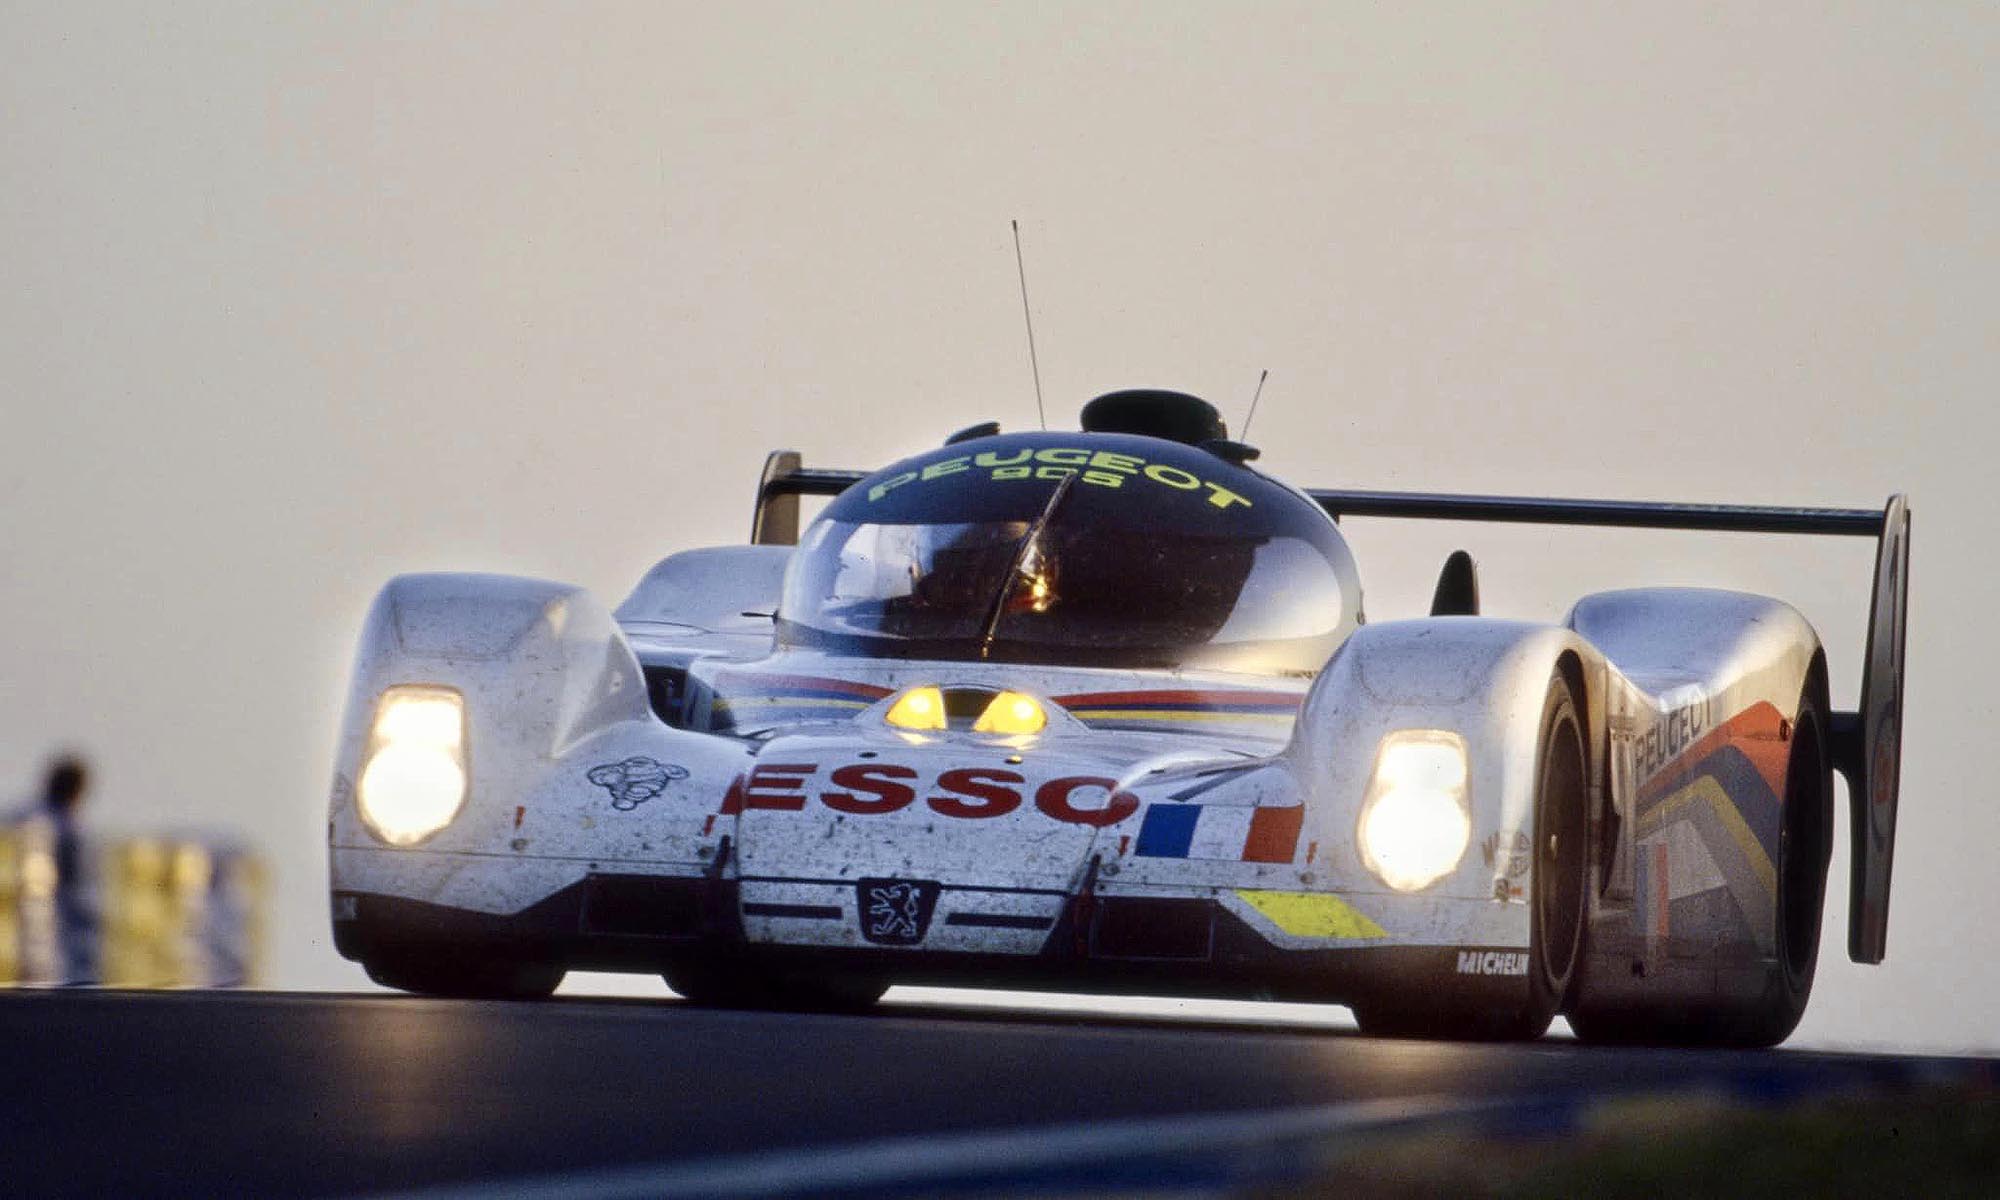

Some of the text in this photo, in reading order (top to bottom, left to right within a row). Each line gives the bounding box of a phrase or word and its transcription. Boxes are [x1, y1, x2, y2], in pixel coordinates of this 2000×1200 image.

[868, 447, 1253, 511] PEUGEOT
[991, 465, 1125, 488] 905
[720, 763, 1140, 828] ESSO
